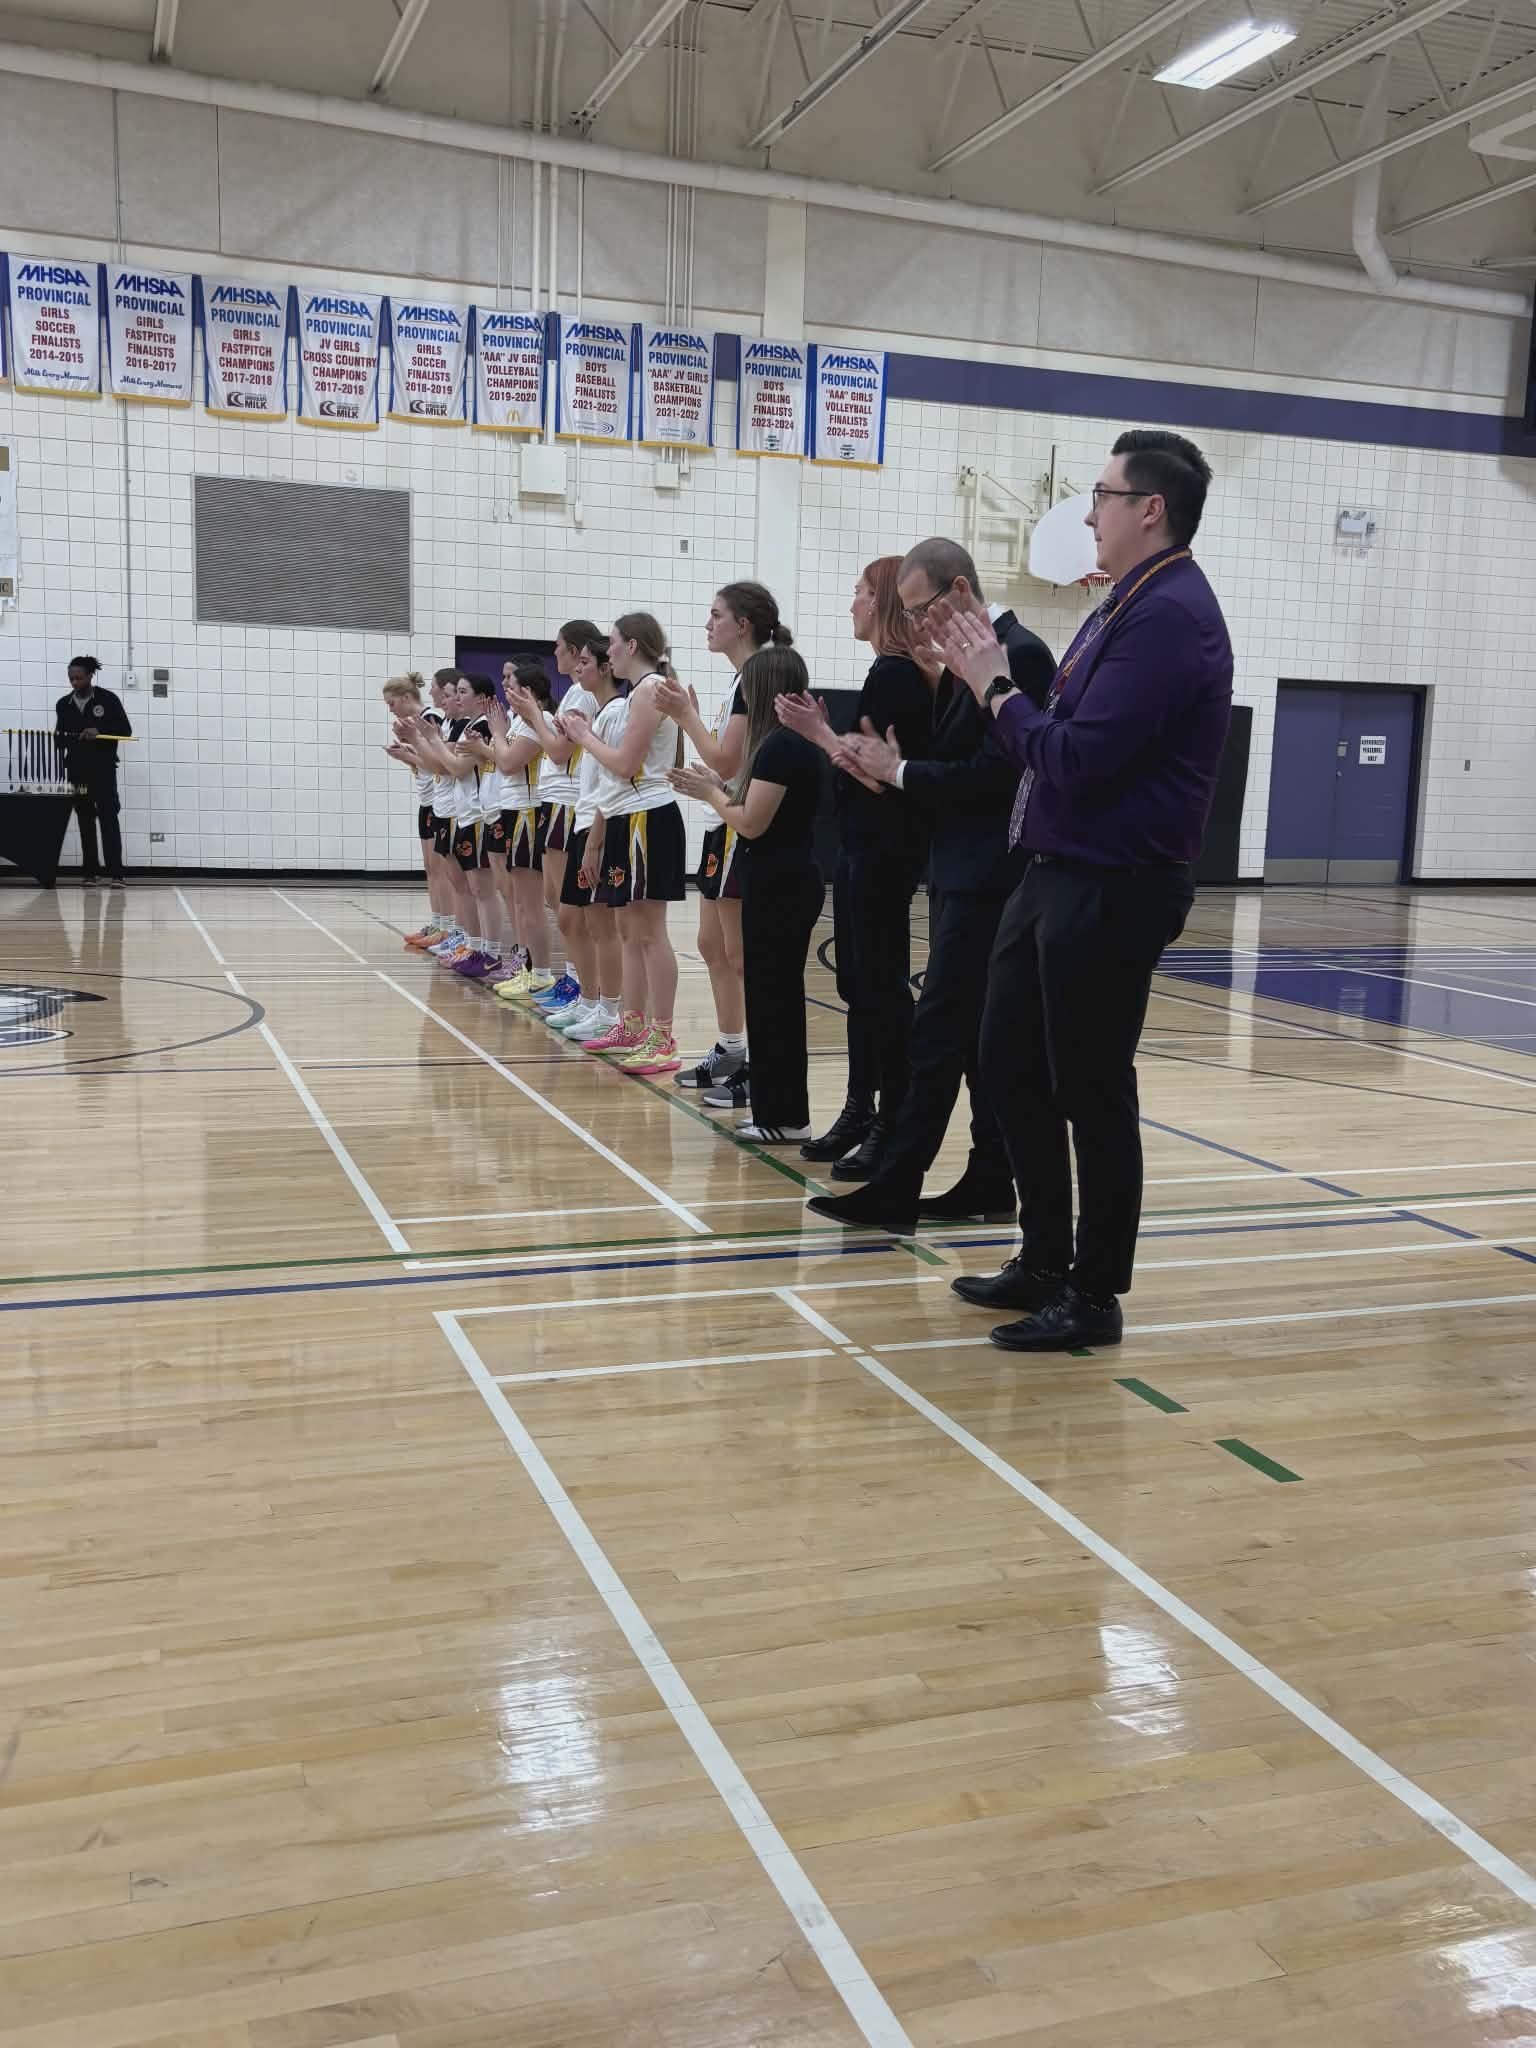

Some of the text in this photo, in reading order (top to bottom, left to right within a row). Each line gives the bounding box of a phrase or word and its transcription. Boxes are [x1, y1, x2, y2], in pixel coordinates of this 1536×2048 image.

[17, 264, 90, 287] MHSAA
[114, 273, 184, 298] MHSAA
[18, 286, 91, 306] PROVINCIAL
[211, 286, 281, 310] MHSAA
[116, 295, 184, 316] PROVINCIAL
[305, 296, 374, 320] MHSAA
[41, 307, 69, 319] GIRLS
[211, 309, 280, 327] PROVINCIAL
[397, 306, 462, 327] MHSAA
[35, 320, 76, 335] SOCCER
[136, 316, 164, 329] GIRLS
[306, 318, 372, 338] PROVINCIAL
[482, 315, 544, 333] MHSAA
[125, 328, 176, 344] FASTPITCH
[233, 329, 261, 341] GIRLS
[397, 326, 461, 343] PROVINCIAL
[565, 323, 628, 345] MHSAA
[32, 335, 81, 349] FINALISTS
[320, 339, 360, 352] JV GIRLS
[649, 332, 709, 353] MHSAA
[30, 349, 84, 363] 2014-2015
[128, 343, 174, 359] FINALISTS
[221, 343, 272, 357] FASTPITCH
[417, 344, 442, 355] GIRLS
[565, 343, 626, 361] PROVINCIAL
[745, 344, 803, 364] MHSAA
[126, 357, 177, 372] 2016-2017
[219, 357, 275, 371] CHAMPIONS
[303, 351, 377, 368] CROSS COUNTRY
[411, 356, 447, 369] SOCCER
[507, 353, 519, 362] JV
[649, 352, 708, 369] PROVINCIAL
[821, 353, 879, 375] MHSAA
[313, 367, 367, 381] CHAMPIONS
[487, 365, 539, 377] VOLLEYBALL
[585, 362, 607, 373] BOYS
[745, 362, 802, 380] PROVINCIAL
[222, 371, 273, 385] 2017-2018
[408, 369, 451, 382] FINALISTS
[575, 374, 616, 387] BASEBALL
[674, 371, 684, 380] JV
[687, 372, 709, 383] GIRLS
[821, 373, 878, 389] PROVINCIAL
[315, 381, 364, 395] 2017-2018
[406, 382, 453, 394] 2018-2019
[487, 378, 539, 389] CHAMPIONS
[653, 382, 703, 395] BASKETBALL
[763, 381, 784, 391] BOYS
[489, 391, 537, 402] 2019-2020
[575, 386, 616, 400] FINALISTS
[756, 393, 791, 404] CURLING
[851, 392, 873, 402] GIRLS
[245, 400, 267, 409] MILK
[573, 400, 618, 413] 2021-2022
[654, 394, 702, 408] CHAMPIONS
[825, 401, 872, 414] VOLLEYBALL
[336, 409, 358, 418] MILK
[425, 407, 447, 416] MILK
[656, 408, 699, 420] 2021-2022
[753, 405, 792, 417] FINALISTS
[752, 418, 794, 430] 2023-2024
[829, 414, 868, 426] FINALISTS
[827, 427, 869, 439] 2024-2025
